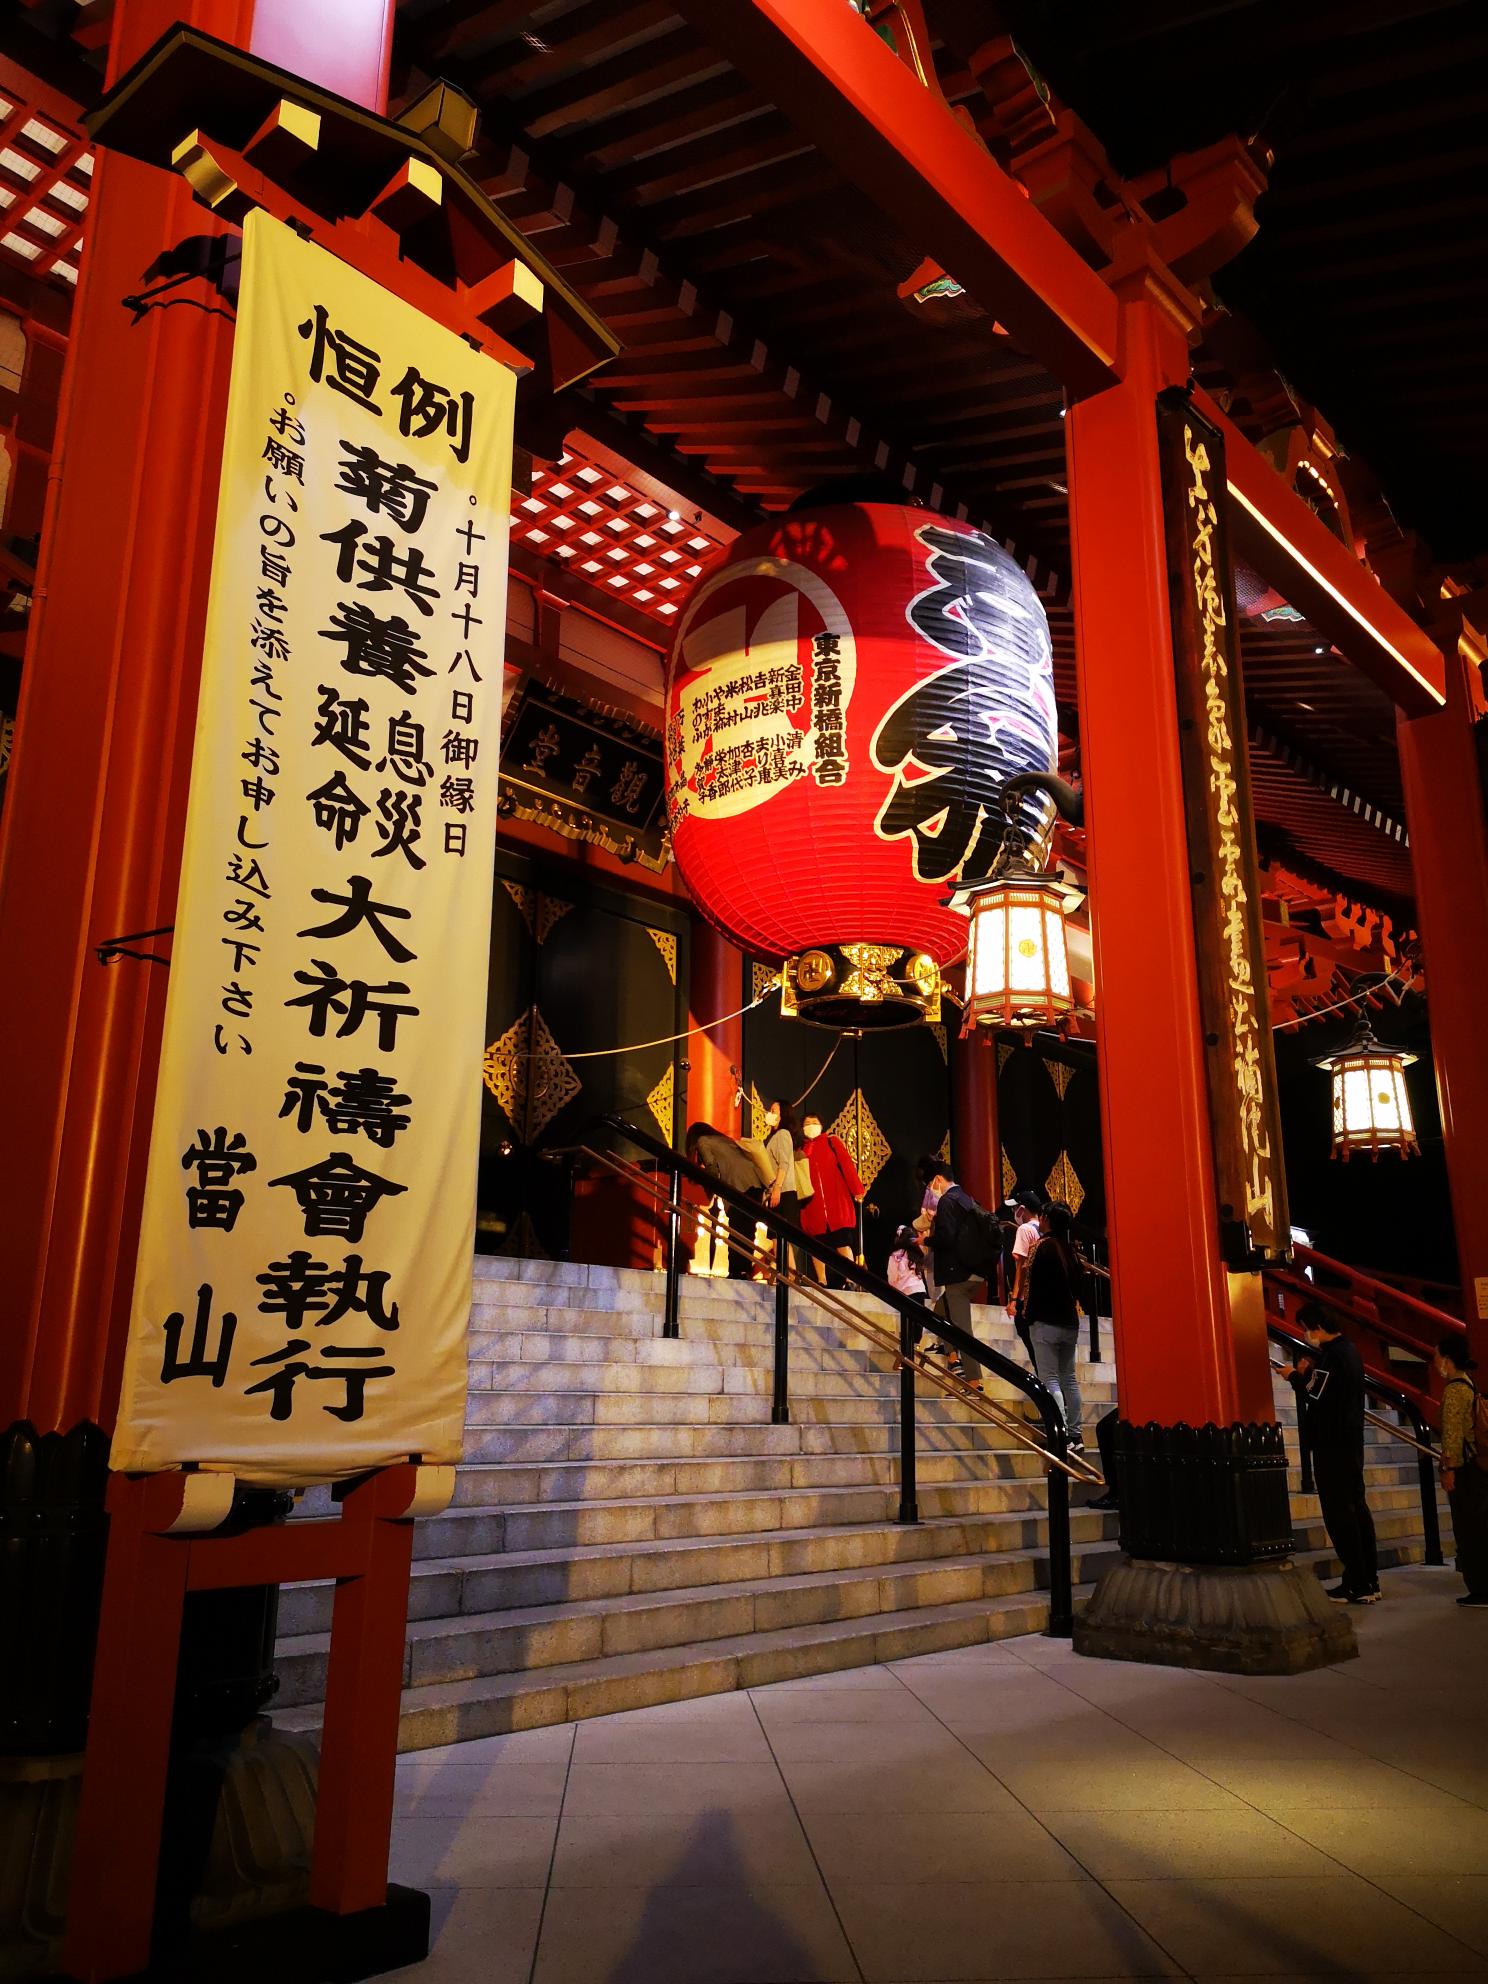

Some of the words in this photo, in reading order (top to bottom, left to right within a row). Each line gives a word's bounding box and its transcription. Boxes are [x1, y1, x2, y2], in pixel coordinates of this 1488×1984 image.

[297, 304, 475, 464] 恒例
[214, 406, 306, 1056] お願いの旨を添えてお申し込み下さい
[306, 684, 373, 852] 延命
[813, 632, 846, 785] 東京新橋組合
[371, 711, 435, 871] 息災
